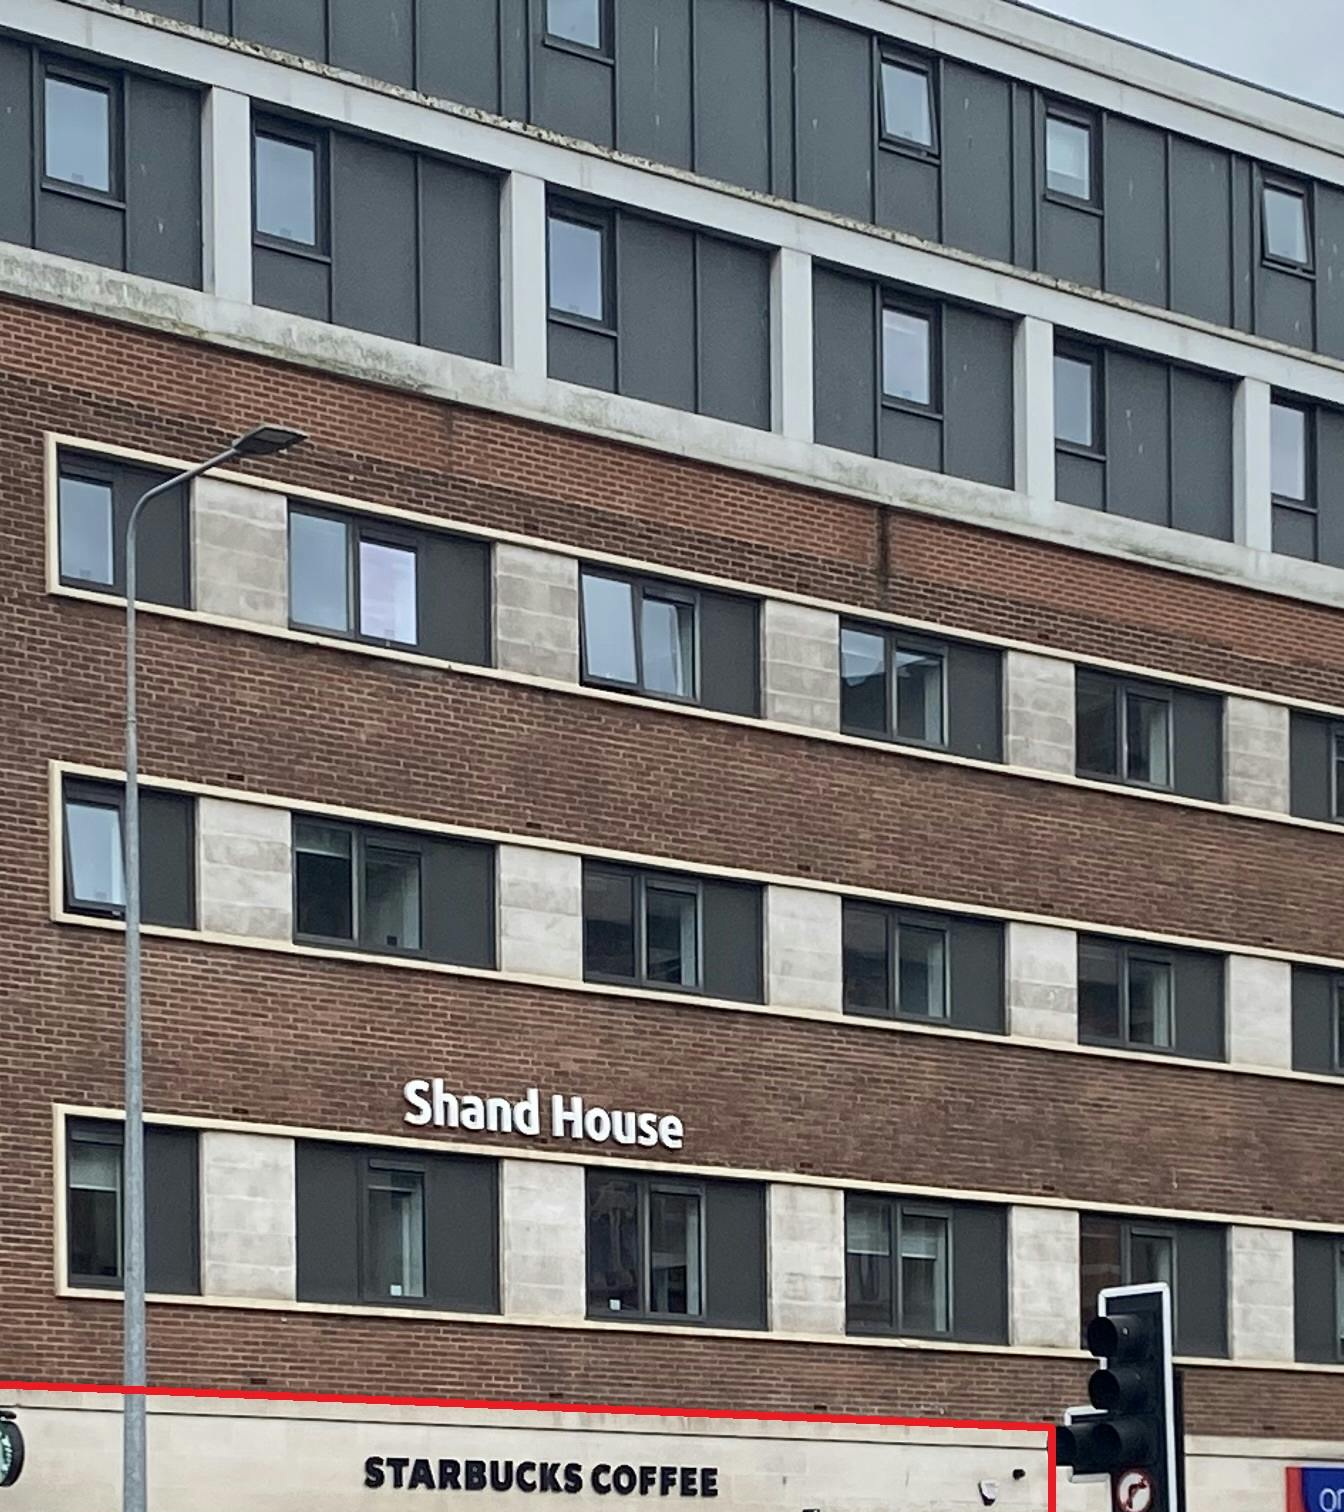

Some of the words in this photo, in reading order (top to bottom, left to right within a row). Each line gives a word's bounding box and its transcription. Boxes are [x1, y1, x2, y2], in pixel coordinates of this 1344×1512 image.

[403, 1078, 539, 1136] Shand
[551, 1095, 684, 1149] House
[364, 1456, 583, 1494] STARBUCKS
[591, 1463, 719, 1498] COFFEE
